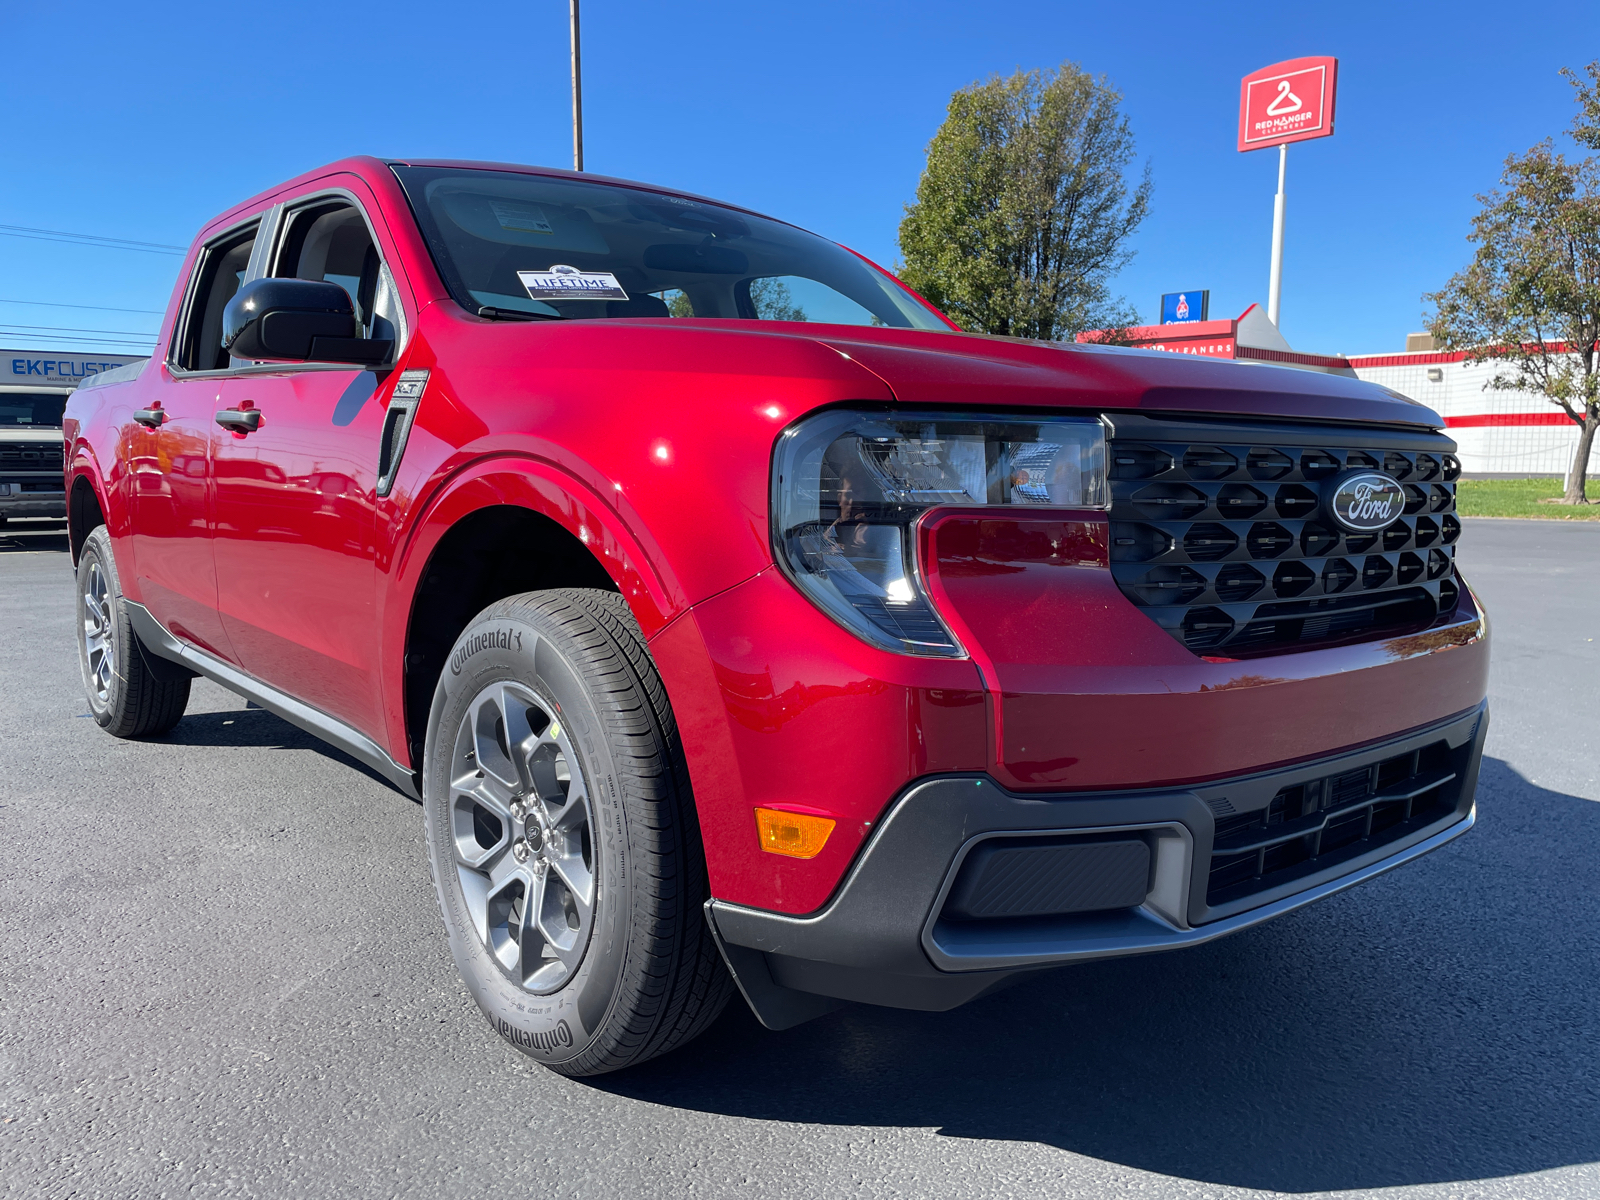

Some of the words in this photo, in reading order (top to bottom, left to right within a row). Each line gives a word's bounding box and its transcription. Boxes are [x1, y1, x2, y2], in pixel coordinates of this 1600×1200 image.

[1255, 121, 1273, 130] RED
[1273, 111, 1313, 126] HANGER
[1261, 121, 1304, 135] CLEANERS
[534, 278, 610, 288] LIFETIME
[1348, 482, 1394, 520] Ford
[450, 627, 513, 677] Continental
[498, 1016, 573, 1055] Continental
